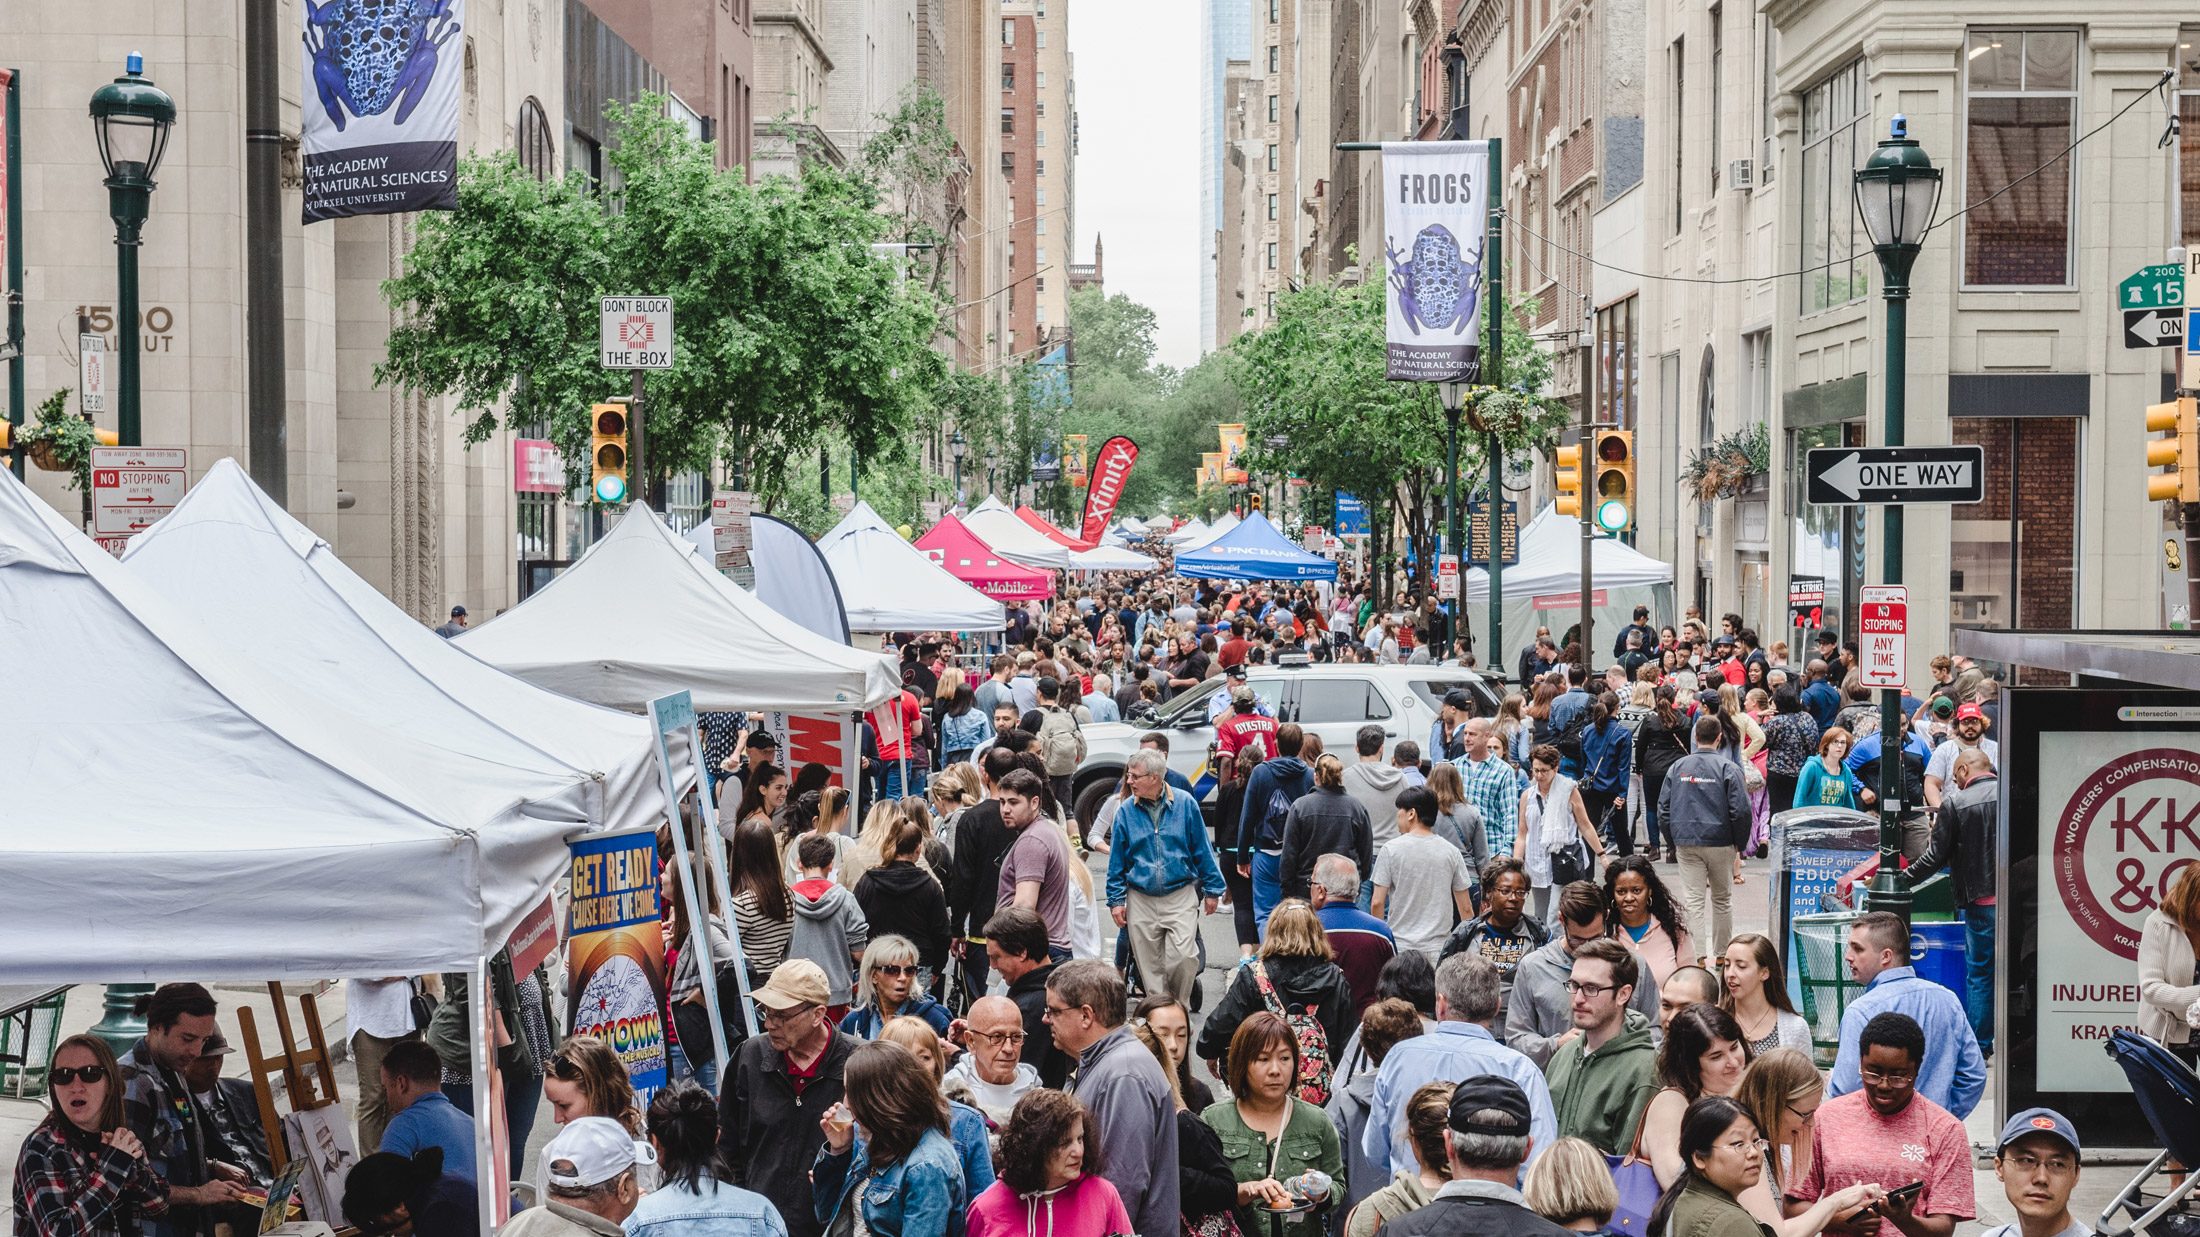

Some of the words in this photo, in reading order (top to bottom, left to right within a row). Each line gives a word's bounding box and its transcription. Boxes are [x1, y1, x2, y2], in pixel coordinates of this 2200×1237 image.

[305, 165, 324, 178] THE
[327, 156, 389, 175] ACADEMY
[306, 183, 318, 195] OF
[321, 176, 378, 194] NATURAL
[381, 170, 448, 187] SCIENCES
[1400, 173, 1471, 204] FROGS
[314, 198, 346, 209] DREXEL
[347, 191, 406, 205] UNIVERSITY
[2155, 267, 2175, 277] 200
[2152, 281, 2183, 305] 15
[636, 300, 668, 313] BLOCK
[78, 305, 173, 333] 50
[607, 352, 632, 364] THE
[640, 352, 667, 365] BOX
[1391, 349, 1407, 359] THE
[1408, 350, 1452, 360] ACADEMY
[1391, 358, 1404, 367] OF
[1404, 359, 1445, 369] NATURAL
[1398, 369, 1422, 377] DREXEL
[100, 473, 115, 485] NO
[122, 473, 170, 485] STOPPING
[1859, 465, 1908, 486] ONE
[1917, 464, 1962, 485] WAY
[1089, 444, 1132, 522] xfinity
[1259, 548, 1299, 558] BANK
[1791, 583, 1800, 593] ON
[1801, 583, 1824, 593] STRIKE
[1878, 605, 1890, 617] NO
[1864, 619, 1903, 631] STOPPING
[1874, 638, 1894, 650] ANY
[1872, 653, 1895, 666] TIME
[1234, 719, 1273, 735] DYKSTRA
[1251, 732, 1268, 758] 4
[2106, 758, 2200, 785] COMPENSATIO
[1821, 796, 1840, 805] SEV
[1795, 857, 1834, 866] SWEEP
[1836, 858, 1863, 867] offic
[573, 853, 603, 898] GET
[606, 846, 657, 893] READY,
[1795, 868, 1843, 881] EDUC
[2064, 856, 2074, 882] NEED
[1794, 883, 1837, 894] resid
[2069, 883, 2081, 904] YOU
[1794, 896, 1816, 906] and
[571, 897, 598, 930] 'CAUSE
[599, 894, 621, 924] HERE
[621, 892, 634, 920] WE
[634, 888, 658, 917] COME.
[2077, 902, 2100, 928] WHEN
[620, 1051, 636, 1064] THE
[637, 1047, 661, 1061] MUSICAL
